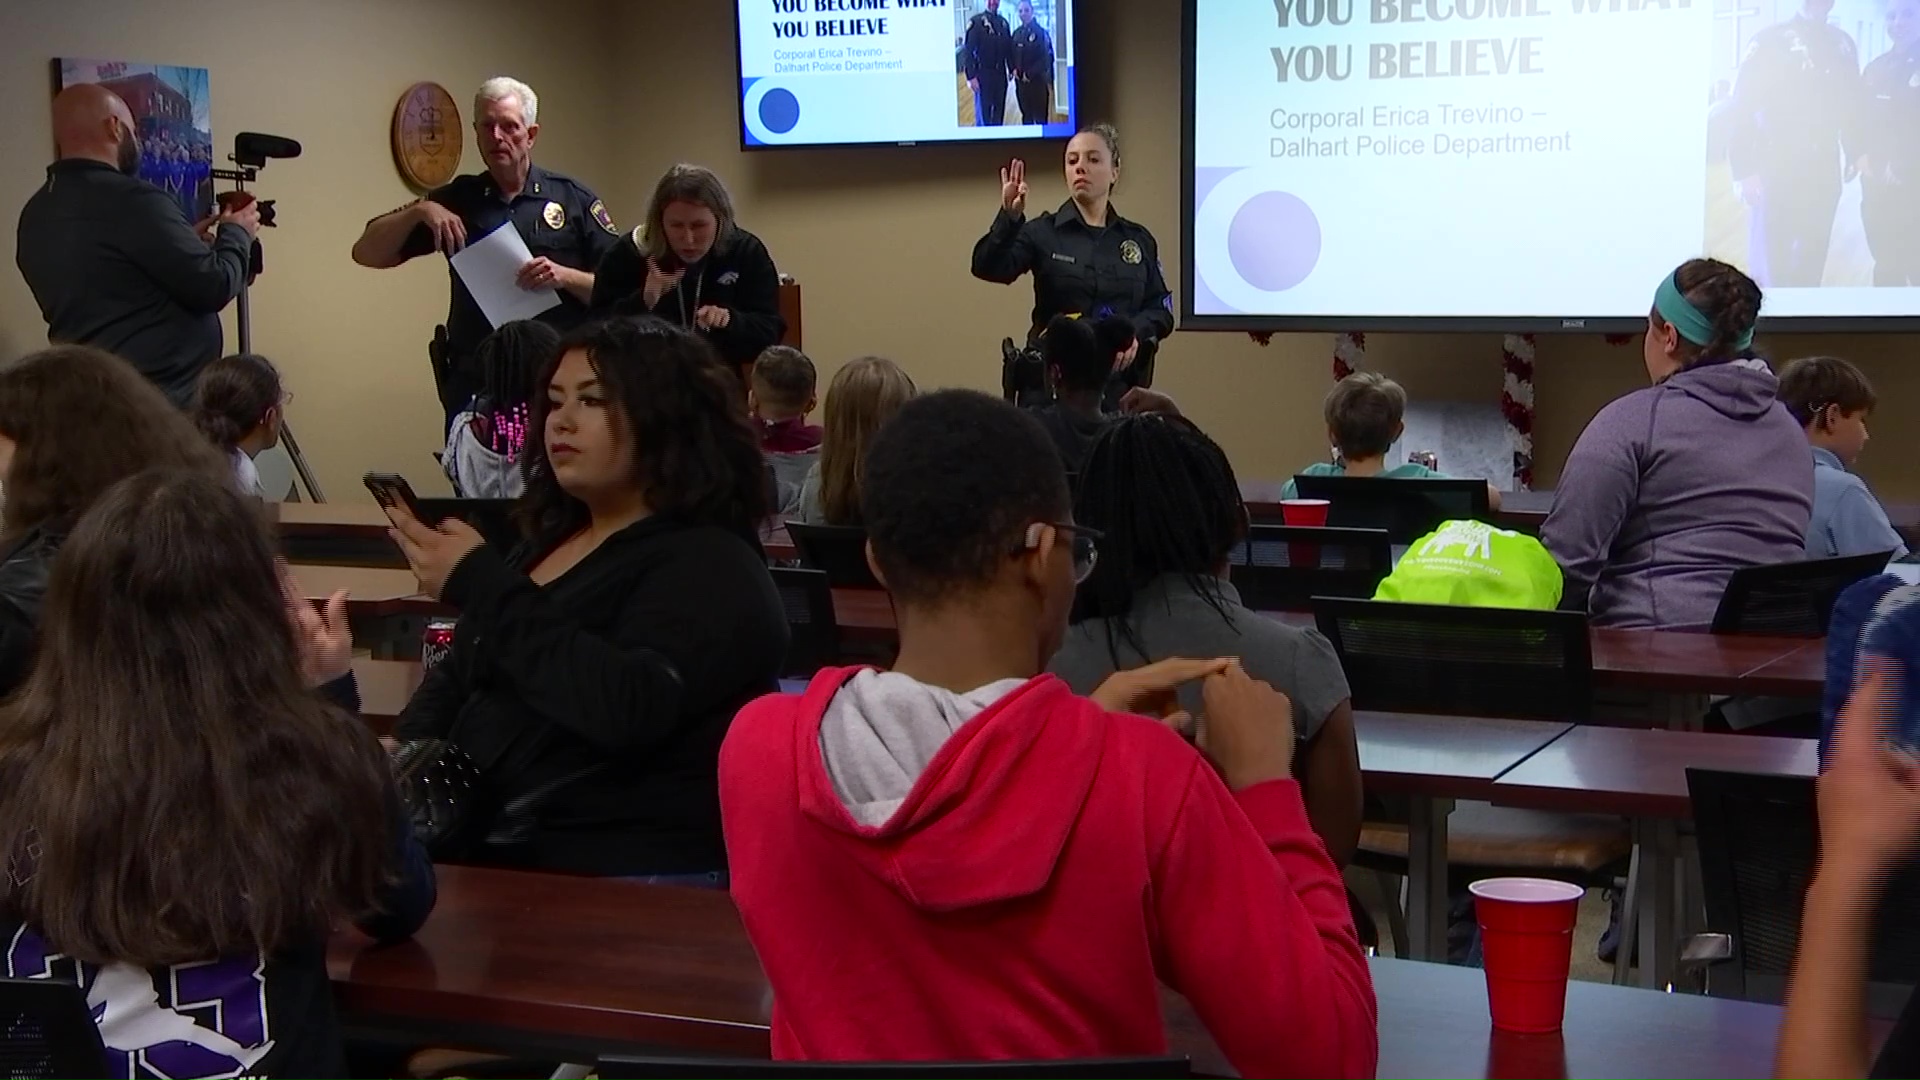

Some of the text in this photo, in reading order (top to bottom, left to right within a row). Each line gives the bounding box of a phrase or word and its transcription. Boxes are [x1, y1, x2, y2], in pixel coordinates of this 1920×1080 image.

[772, 0, 808, 13] YOU
[814, 0, 890, 12] BECOME
[1273, 0, 1353, 28] YOU
[772, 18, 889, 38] YOU BELIEVE
[773, 49, 816, 61] Corporal
[818, 48, 843, 59] Erica
[846, 47, 882, 58] Trevino
[1270, 36, 1544, 83] YOU BELIEVE
[774, 60, 902, 73] Dalhart Police Department
[1270, 106, 1364, 133] Corporal
[1373, 105, 1429, 127] Erica
[1438, 103, 1523, 125] Trevino
[1270, 131, 1571, 159] Dalhart Police Department
